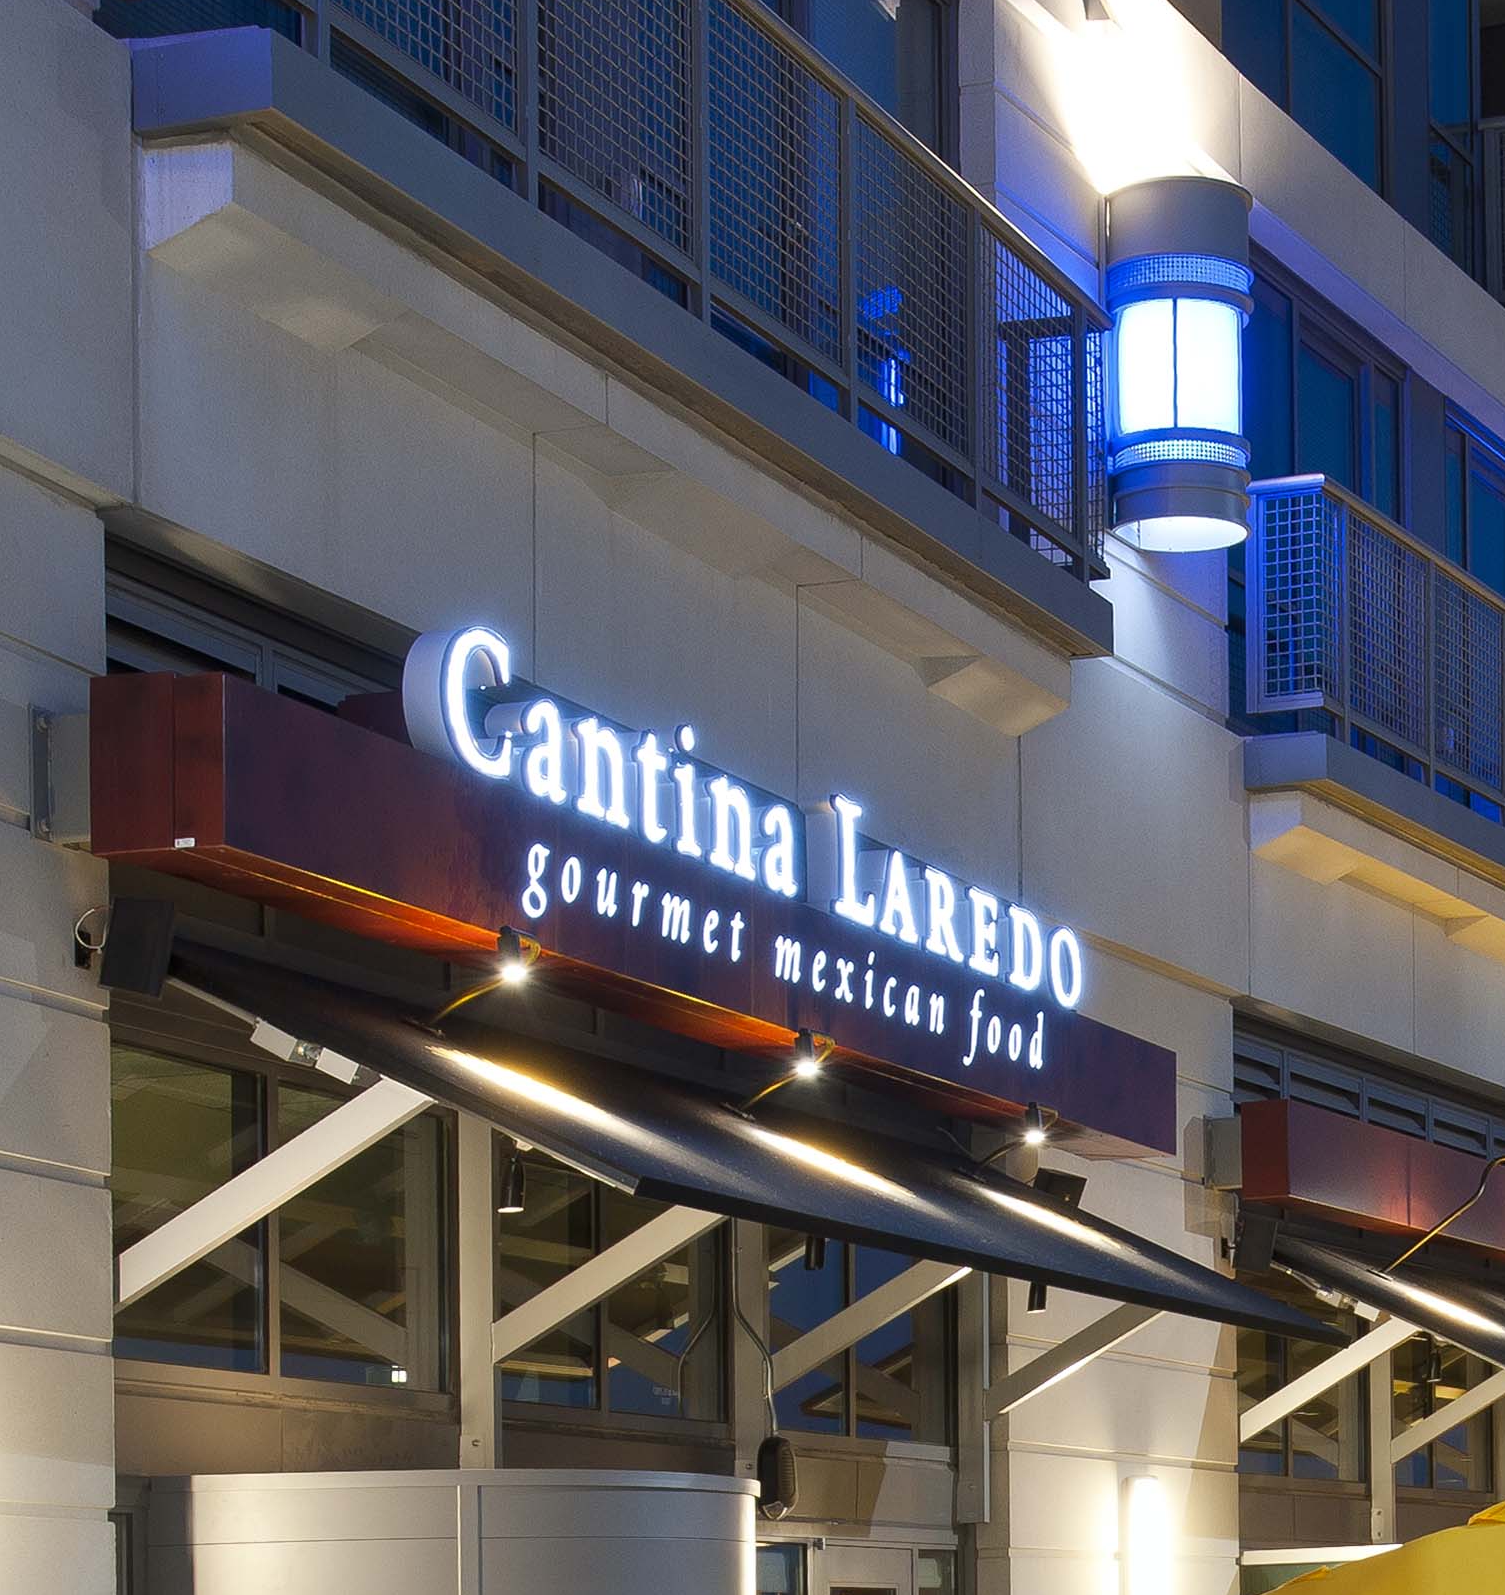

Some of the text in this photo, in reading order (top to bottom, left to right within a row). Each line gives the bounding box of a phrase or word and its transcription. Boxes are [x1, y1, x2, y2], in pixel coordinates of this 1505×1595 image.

[436, 624, 1083, 1008] Cantina LAREDO
[521, 842, 1046, 1070] gourmet mexican food
